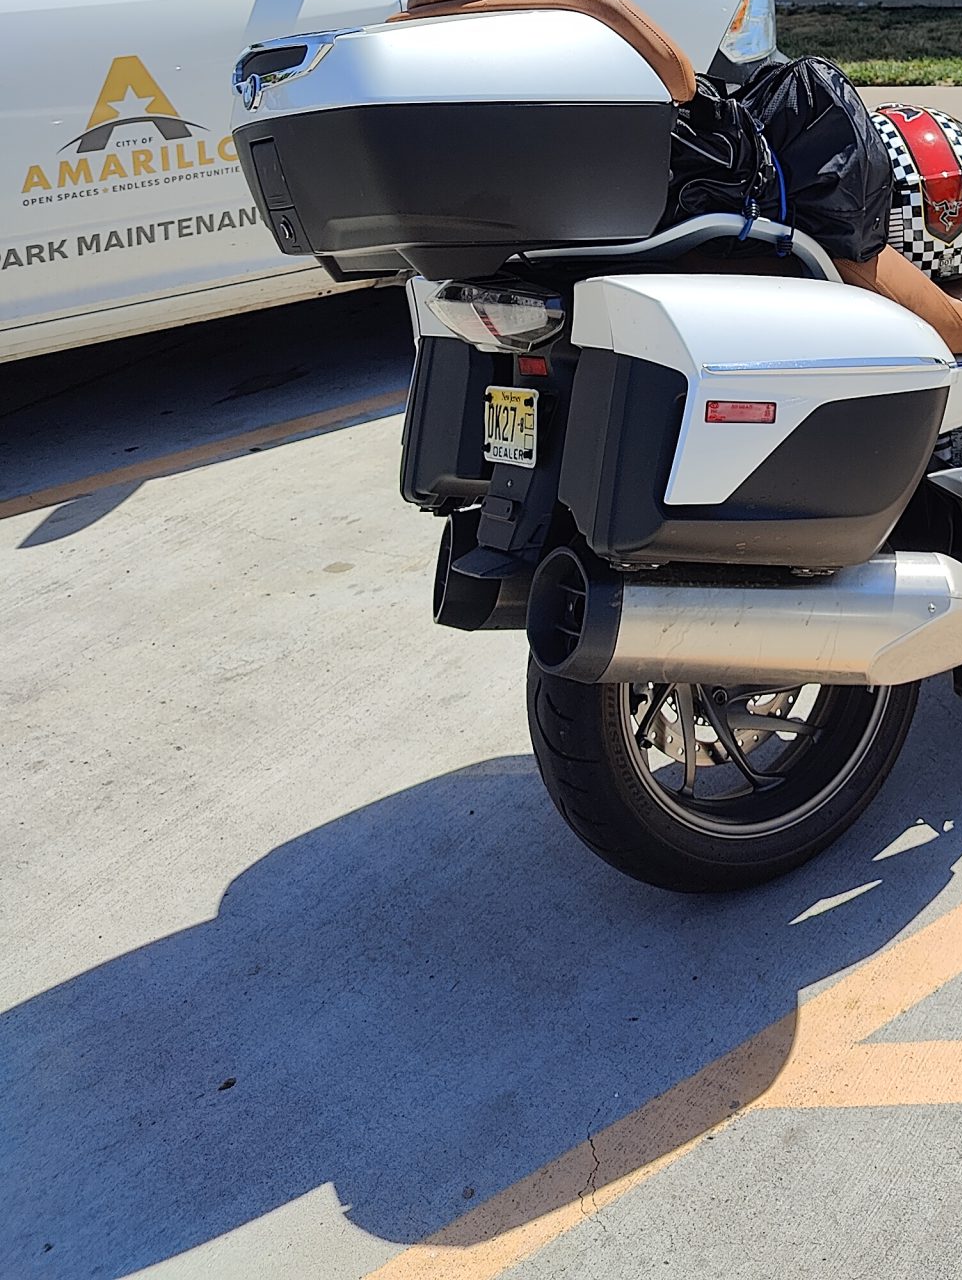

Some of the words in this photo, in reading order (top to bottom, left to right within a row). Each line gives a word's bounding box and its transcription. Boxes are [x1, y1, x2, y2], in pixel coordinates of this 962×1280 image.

[116, 139, 138, 148] CITY
[141, 136, 154, 144] OF
[22, 195, 53, 207] OPEN
[57, 188, 100, 201] SPACES
[112, 178, 160, 192] ENDLESS
[164, 165, 241, 184] OPPORTUNITIE
[0, 239, 68, 270] ARK
[77, 206, 259, 256] MAINTENAN
[501, 391, 510, 401] New
[493, 446, 524, 461] DEALER
